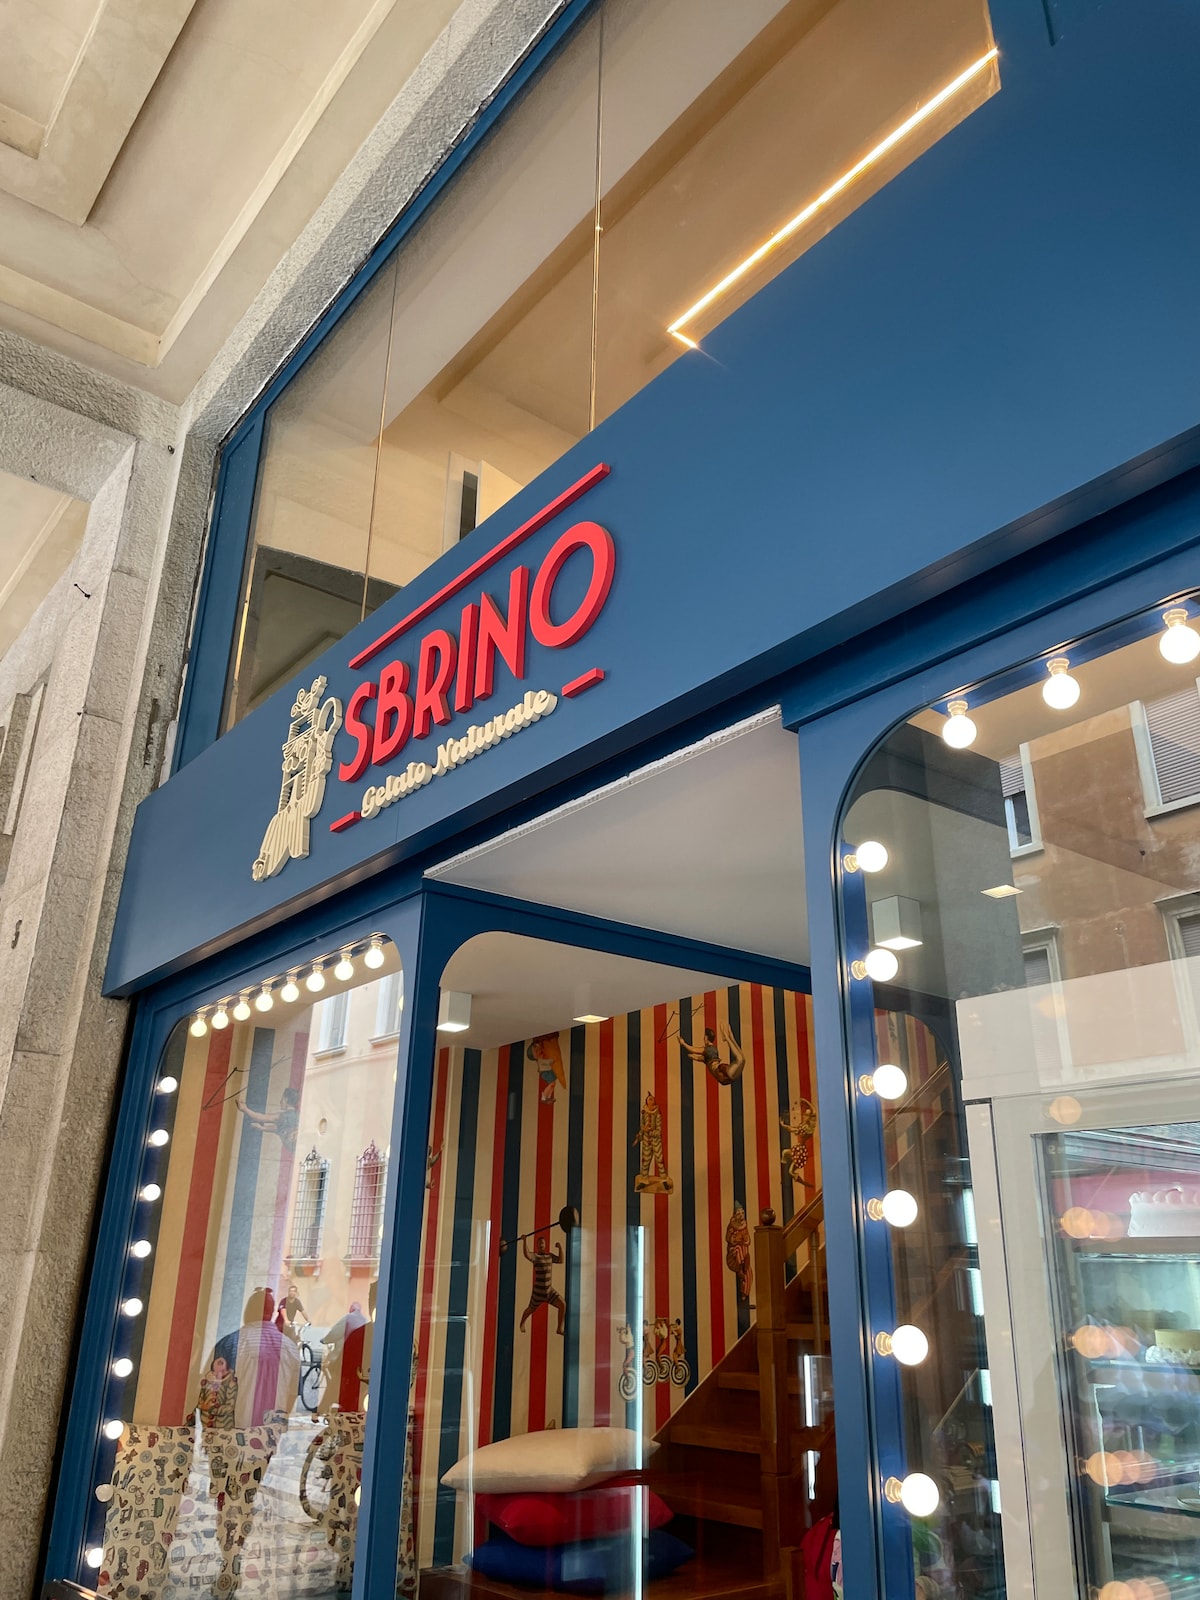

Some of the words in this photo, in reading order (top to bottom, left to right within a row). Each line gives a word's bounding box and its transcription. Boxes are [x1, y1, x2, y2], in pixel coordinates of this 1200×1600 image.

[339, 521, 615, 782] SBRINO
[361, 762, 433, 819] Gelato
[432, 689, 558, 777] Naturale
